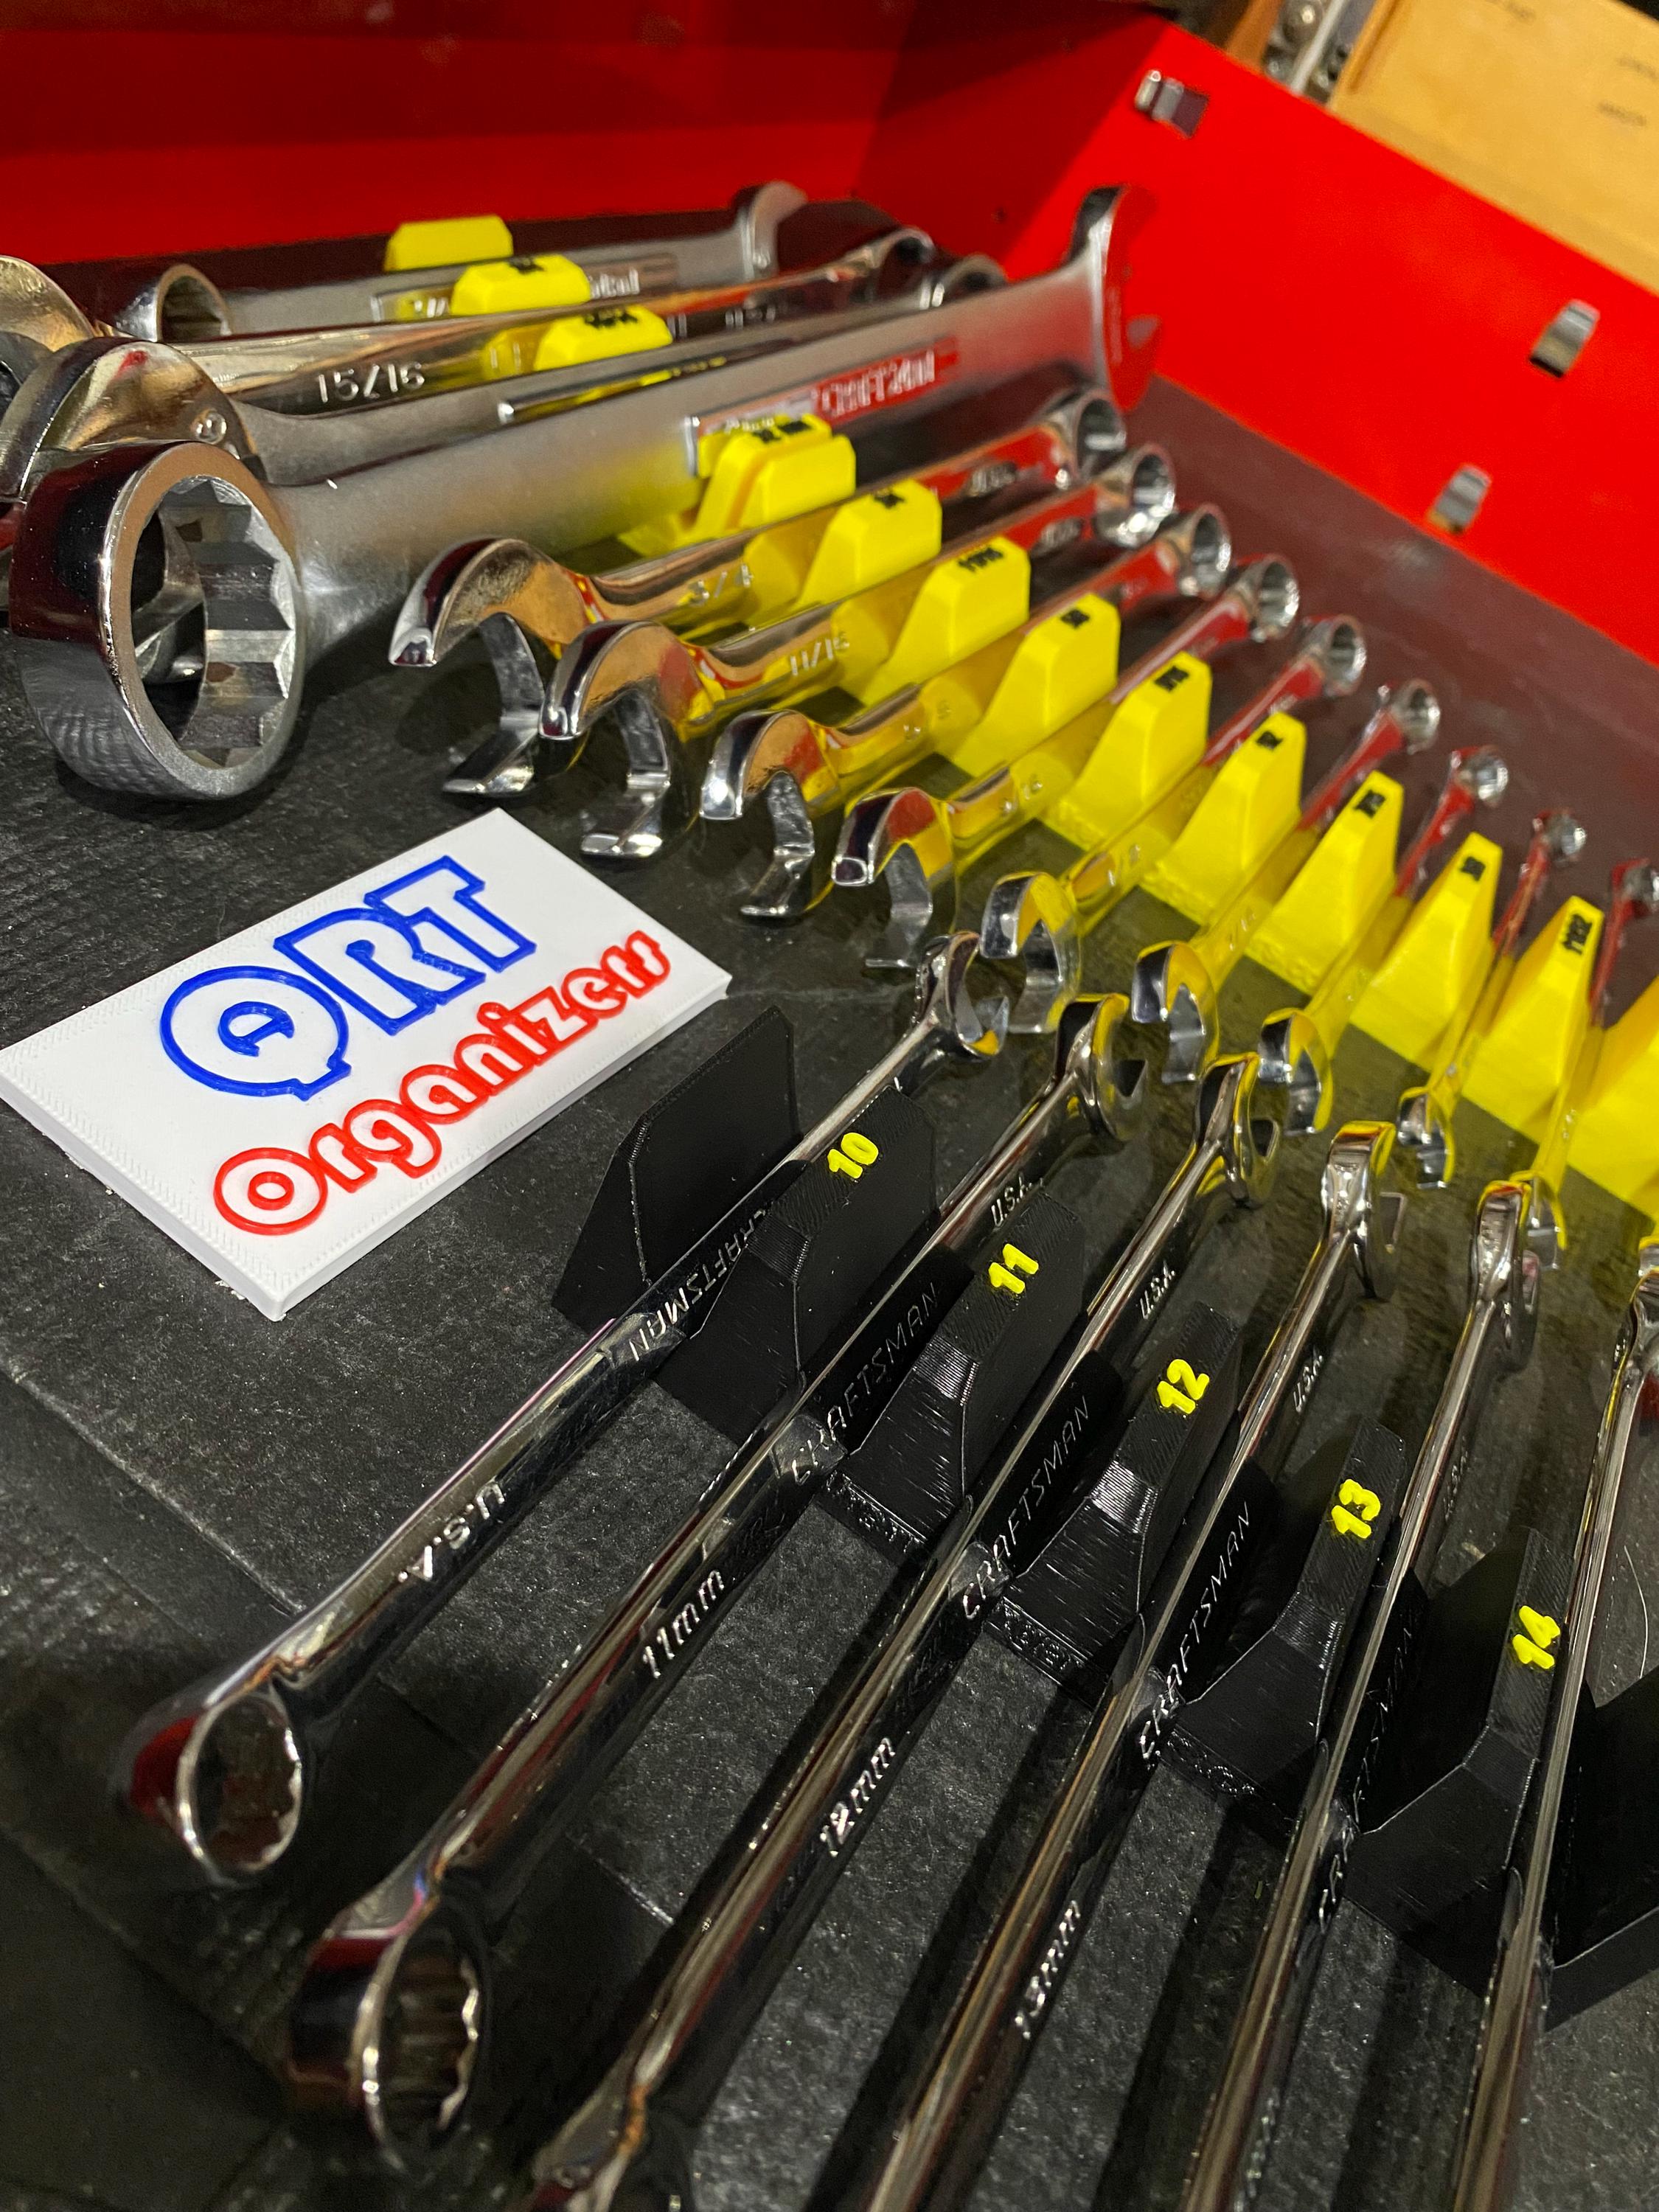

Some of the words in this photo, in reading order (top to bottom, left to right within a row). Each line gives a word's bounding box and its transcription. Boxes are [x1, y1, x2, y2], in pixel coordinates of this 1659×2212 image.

[317, 361, 425, 403] 15/16
[159, 855, 537, 1101] QRT
[213, 929, 671, 1236] Organizers
[828, 1132, 880, 1180] 10
[988, 1243, 1039, 1295] 11
[791, 1281, 940, 1485] CRAFTSMAN
[1156, 1358, 1209, 1415] 12
[962, 1394, 1090, 1621] CRAFTSMAN
[1331, 1478, 1381, 1539] 13
[641, 1568, 724, 1679] 11mm
[1139, 1500, 1250, 1759] CRAFTSMAN
[1512, 1605, 1561, 1669] 14
[820, 1737, 895, 1857] 12mm
